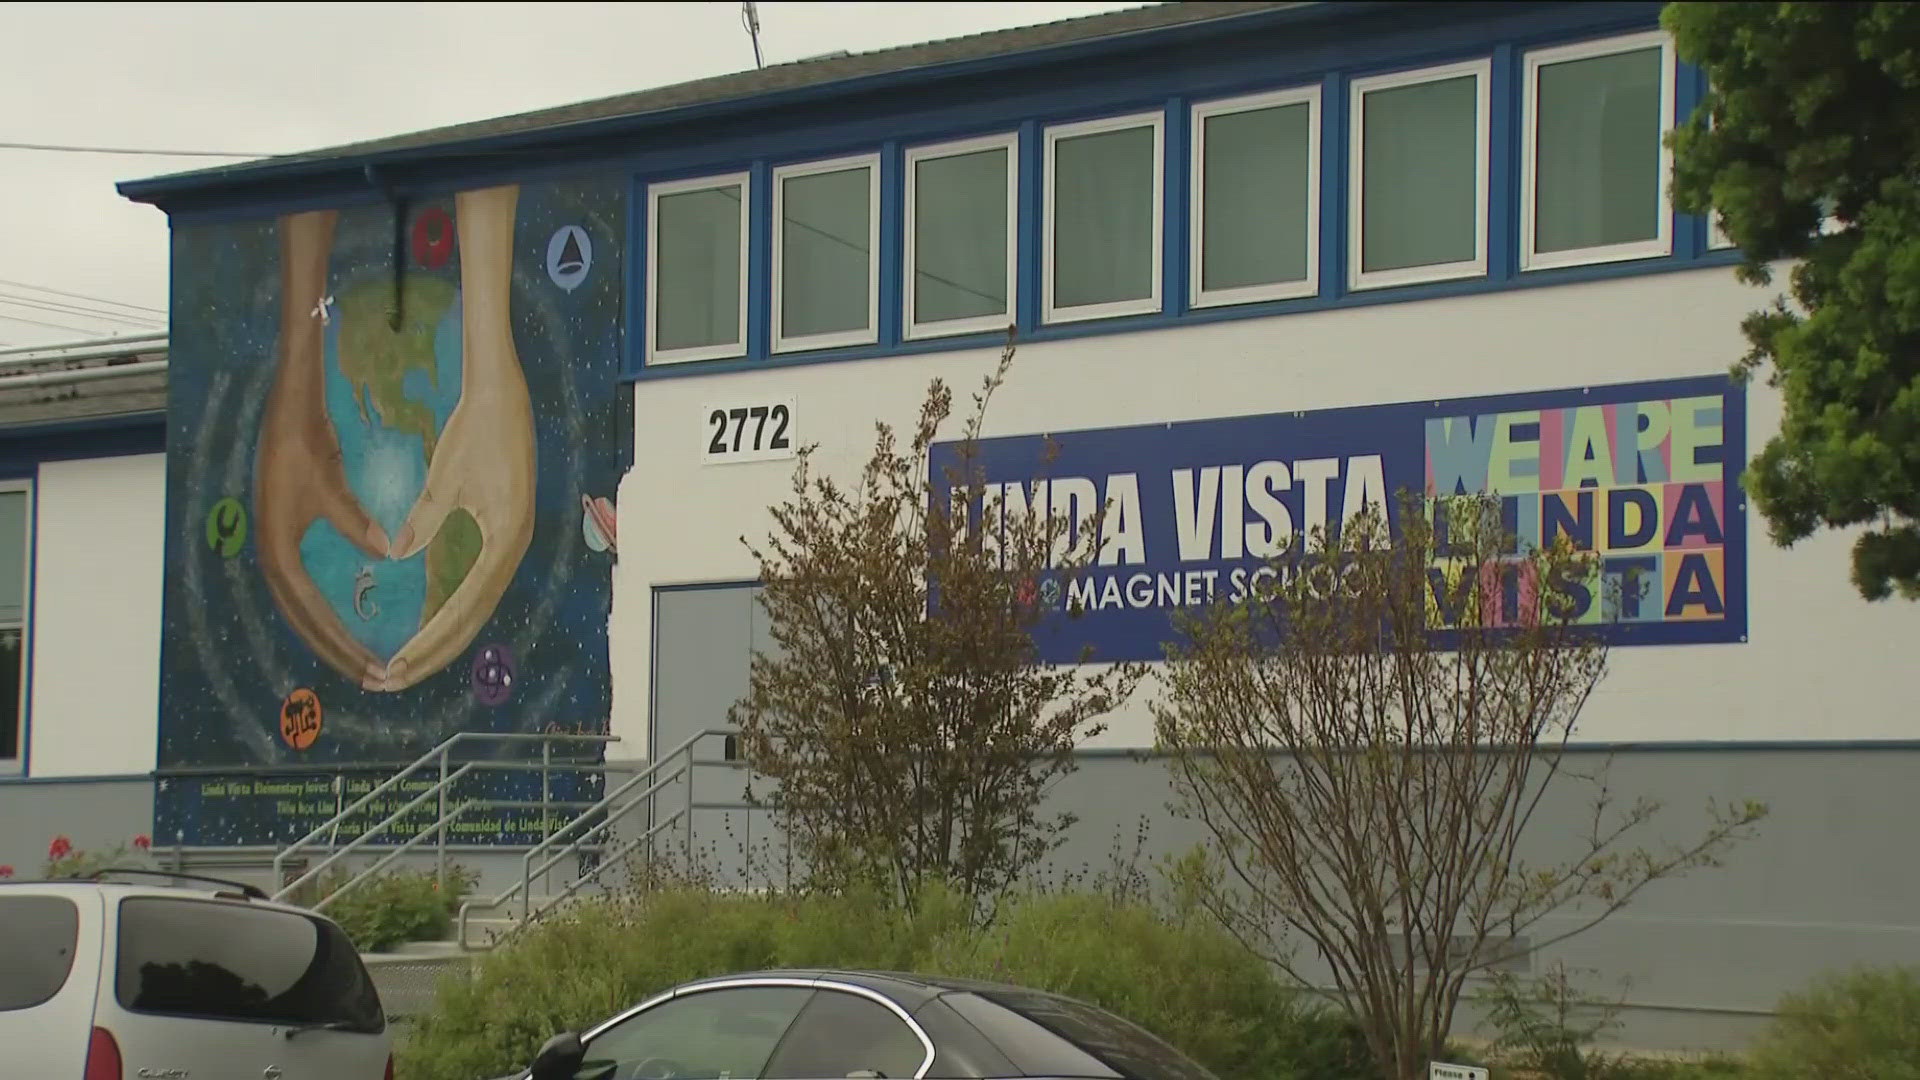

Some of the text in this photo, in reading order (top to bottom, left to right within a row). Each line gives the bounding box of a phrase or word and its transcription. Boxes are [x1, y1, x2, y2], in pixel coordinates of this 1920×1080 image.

[708, 404, 790, 454] 2772
[1425, 395, 1724, 497] WE ARE
[950, 454, 1392, 570] LINDA VISTA
[1433, 484, 1725, 557] LINDA
[1066, 569, 1219, 612] MAGNET
[1427, 553, 1725, 628] VISTA
[451, 819, 502, 832] Comunidad
[504, 818, 517, 831] de
